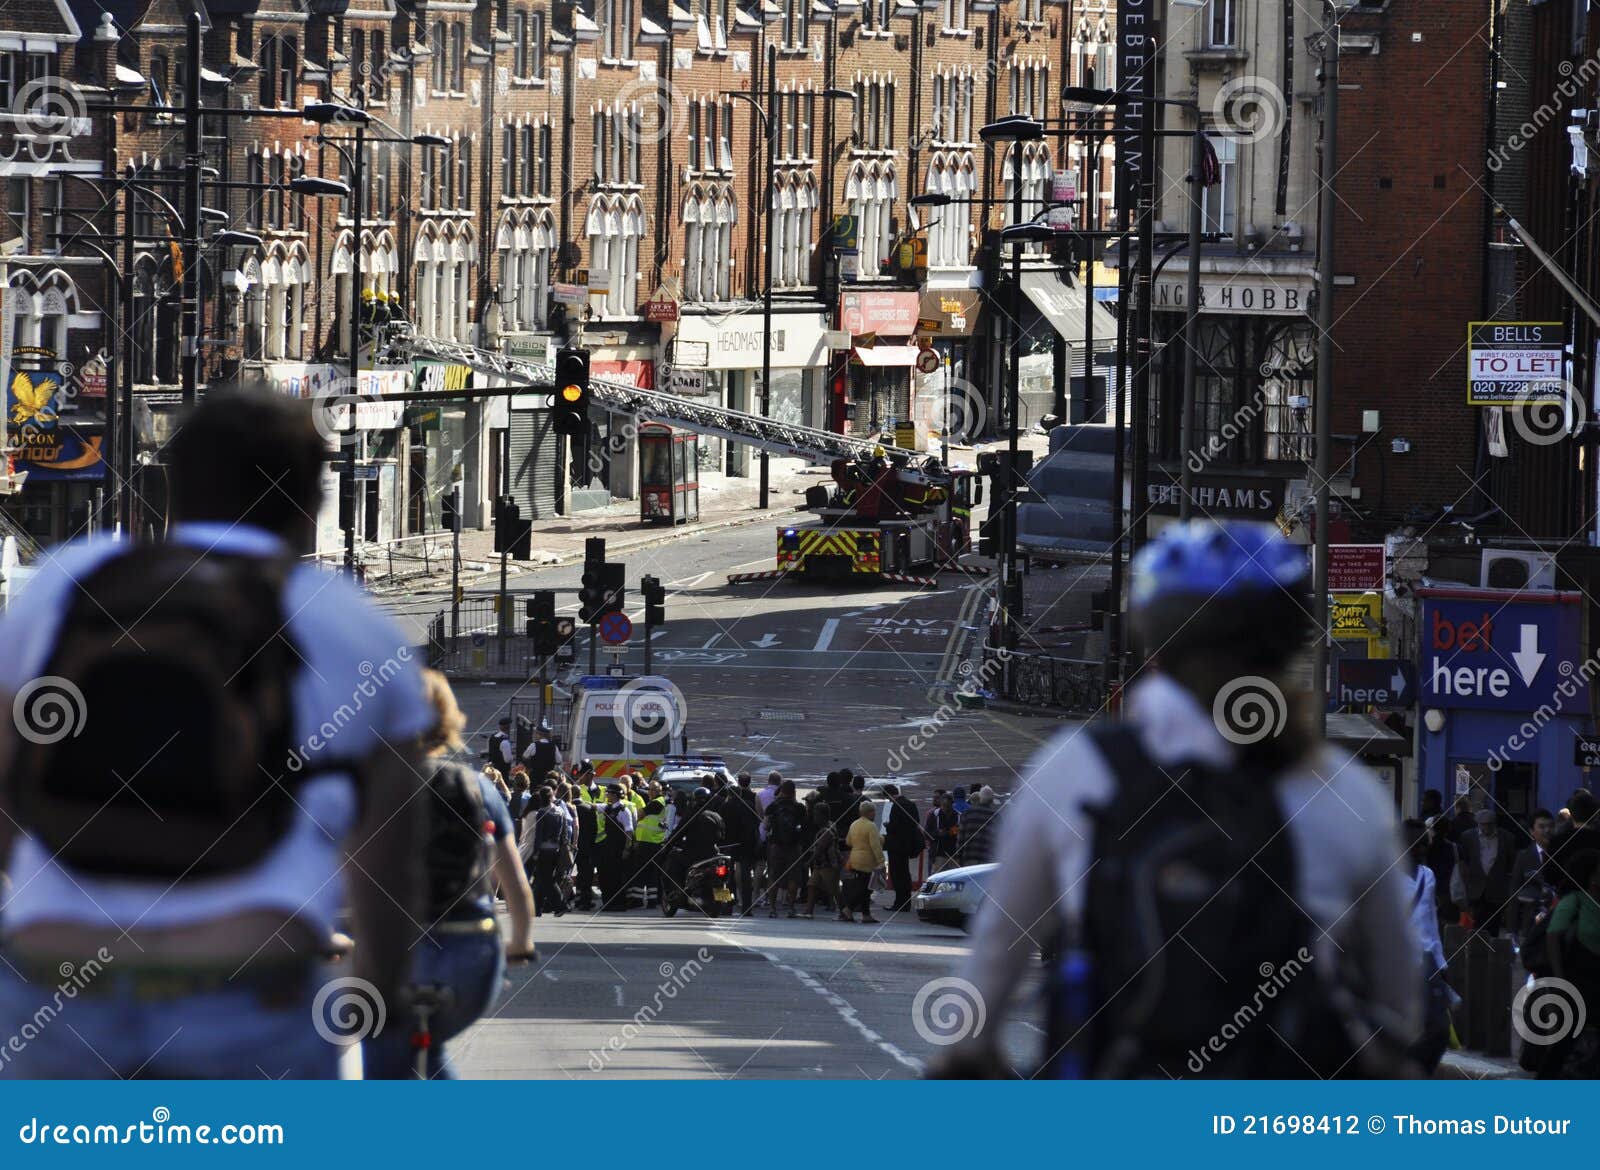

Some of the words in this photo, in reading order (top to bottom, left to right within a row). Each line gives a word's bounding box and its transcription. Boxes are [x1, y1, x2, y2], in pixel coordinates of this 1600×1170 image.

[1124, 0, 1144, 180] EBENHAM
[717, 330, 778, 352] HEADMASTS
[1494, 326, 1542, 342] BELLS
[512, 341, 546, 349] VISION
[1475, 358, 1508, 372] TO
[1517, 358, 1560, 372] LET
[421, 364, 473, 391] SUBWAY
[672, 377, 701, 389] LOANS
[1473, 382, 1496, 393] 020
[1500, 382, 1528, 393] 7228
[1533, 382, 1561, 393] 4405
[1147, 484, 1273, 510] EBEHAMS
[1332, 606, 1367, 618] SNAPPY
[1432, 610, 1495, 652] bet
[1432, 656, 1511, 698] here
[1341, 684, 1389, 703] here
[594, 703, 621, 711] POLICE
